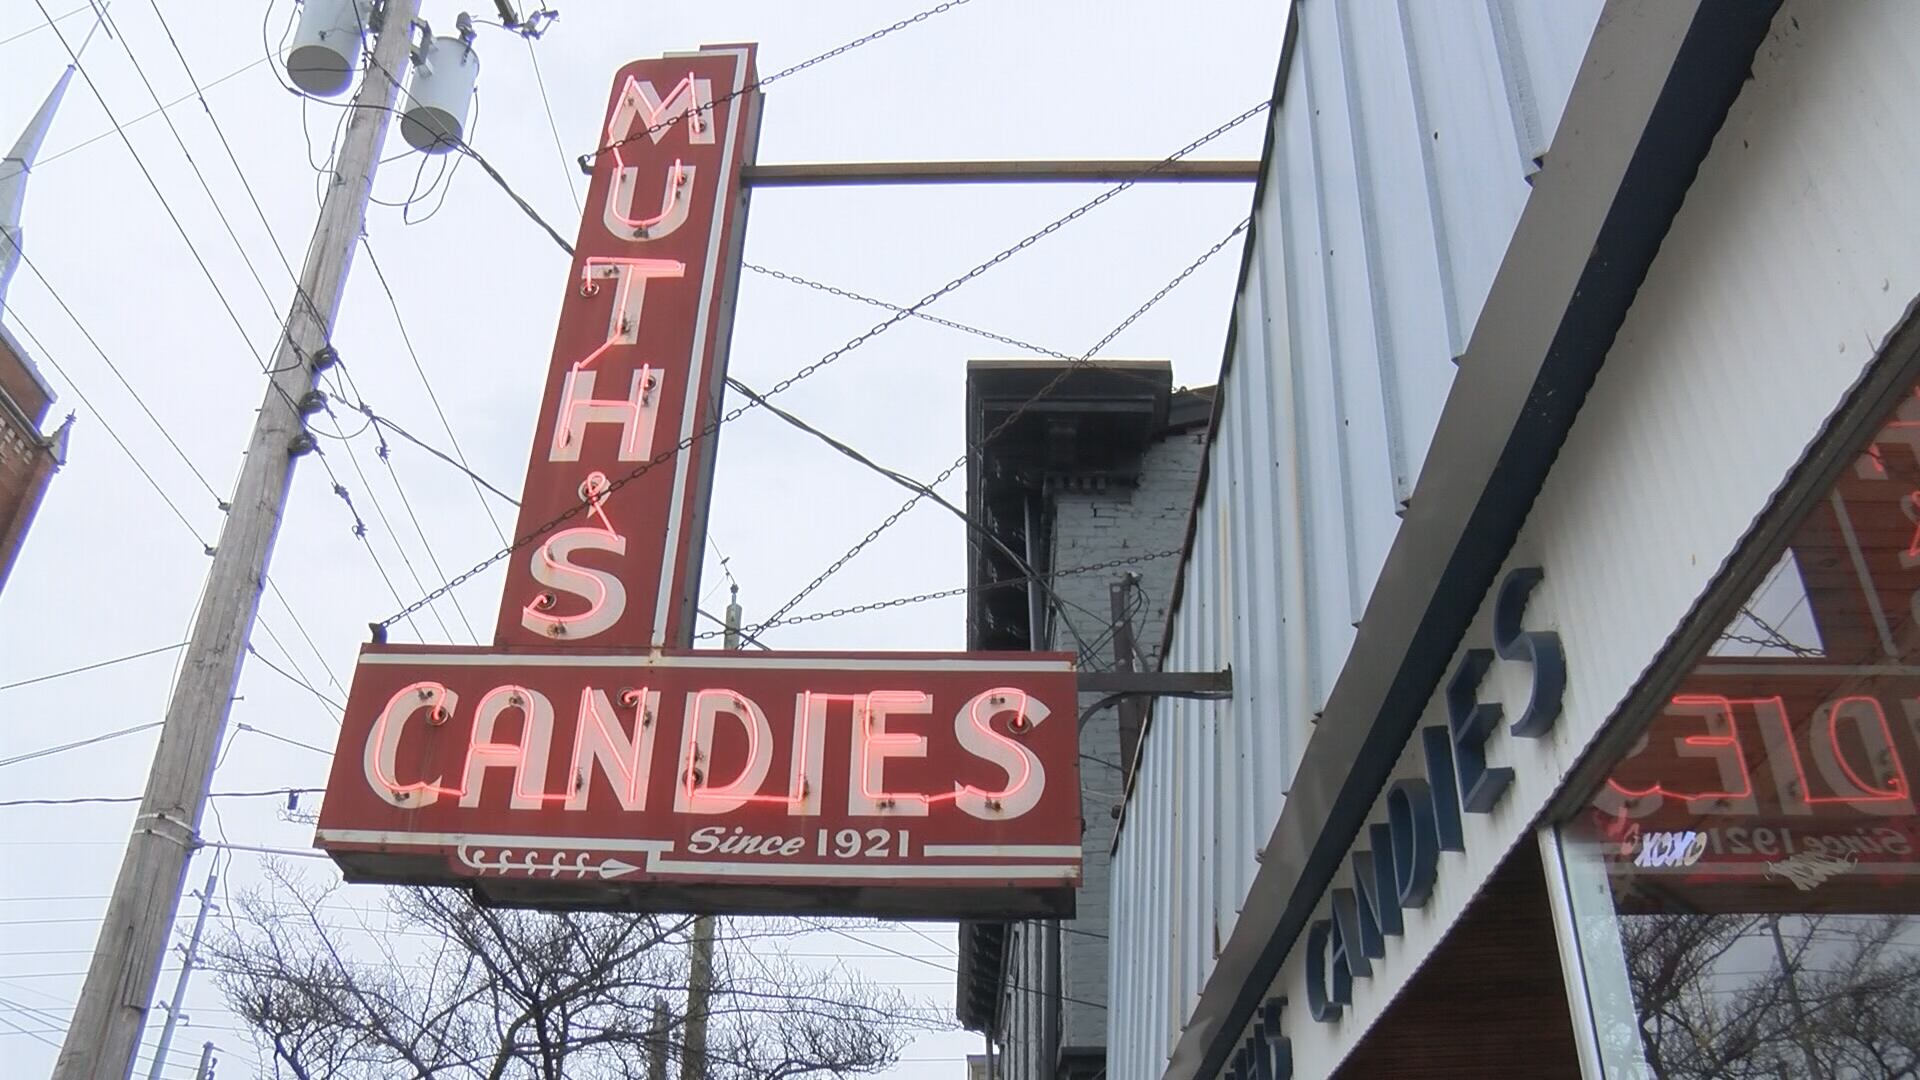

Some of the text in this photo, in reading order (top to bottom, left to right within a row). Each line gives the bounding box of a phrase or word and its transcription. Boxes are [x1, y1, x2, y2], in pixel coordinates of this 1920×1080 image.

[364, 684, 1051, 821] CANDIES
[1306, 566, 1566, 1022] CANDIES
[688, 826, 909, 858] Since 1921
